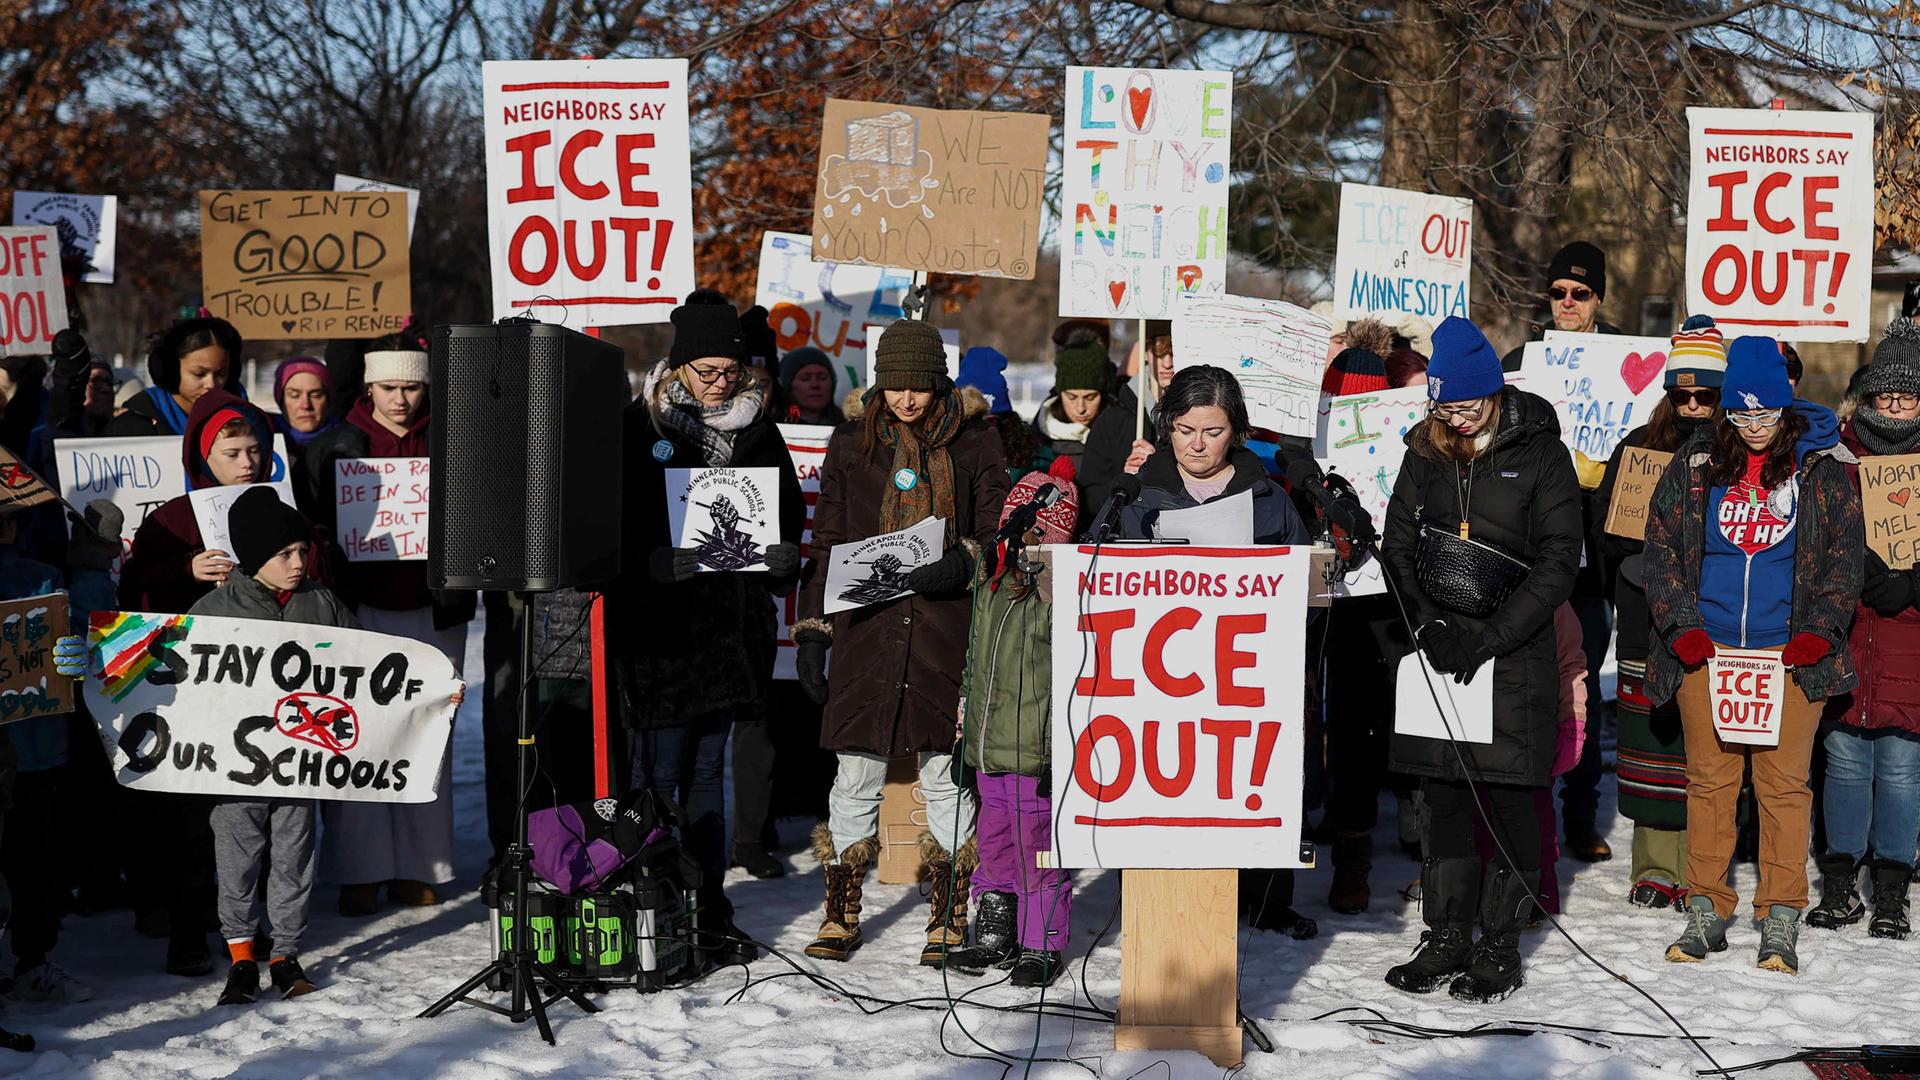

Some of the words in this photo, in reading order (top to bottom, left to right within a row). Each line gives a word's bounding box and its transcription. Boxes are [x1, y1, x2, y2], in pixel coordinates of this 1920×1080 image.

[503, 100, 622, 125] NEIGHBORS
[629, 103, 666, 121] SAY
[1080, 70, 1227, 138] LOVE
[937, 115, 1009, 166] WE
[1706, 145, 1810, 165] NEIGHBORS
[1816, 149, 1849, 165] SAY
[505, 129, 659, 207] ICE
[1075, 139, 1214, 193] THY
[938, 171, 977, 205] Are
[992, 168, 1046, 210] NOT
[1707, 170, 1839, 240] ICE
[209, 192, 272, 223] GET
[287, 195, 390, 219] INTO
[821, 217, 901, 263] Your
[1074, 203, 1226, 260] NEIGH
[1355, 202, 1409, 245] ICE
[1421, 213, 1469, 258] OUT
[234, 229, 386, 274] GOOD
[508, 215, 674, 290] OUT!
[1394, 250, 1408, 269] of
[1350, 268, 1466, 318] MINNESOTA
[1701, 244, 1850, 314] OUT!
[211, 281, 383, 317] TROUBLE!
[300, 318, 336, 332] RIP
[345, 315, 403, 331] RENEE
[768, 301, 885, 357] OU
[1545, 347, 1584, 369] WE
[72, 451, 161, 493] DONALD
[339, 461, 396, 476] WOULD
[798, 464, 822, 480] SA
[1629, 452, 1667, 475] Min
[339, 484, 366, 505] BE
[372, 484, 399, 502] IN
[686, 468, 736, 493] MINNEAPOLIS
[742, 476, 765, 512] FAMILIES
[713, 477, 739, 488] PUBLIC
[740, 486, 757, 518] SCHOOLS
[1621, 481, 1642, 494] are
[376, 511, 426, 527] BUT
[1615, 504, 1645, 519] need
[1874, 513, 1920, 538] MEL
[345, 527, 390, 557] HERE
[395, 531, 428, 557] IN
[850, 534, 905, 558] MINNEAPOLIS
[909, 535, 930, 559] FAMILIES
[907, 543, 921, 564] SCHOOLS
[1078, 570, 1227, 597] NEIGHBORS
[1235, 574, 1284, 597] SAY
[0, 607, 48, 656] CE
[19, 650, 48, 673] NOT
[146, 626, 267, 688] STAY
[271, 640, 365, 700] OUT
[369, 652, 424, 706] OF
[1075, 606, 1267, 708] ICE
[1717, 661, 1760, 670] NEIGHBORS
[1717, 670, 1771, 699] ICE
[1718, 699, 1774, 728] OUT!
[118, 712, 217, 773] OUR
[227, 715, 410, 791] SCHOOLS
[1074, 714, 1282, 811] OUT!
